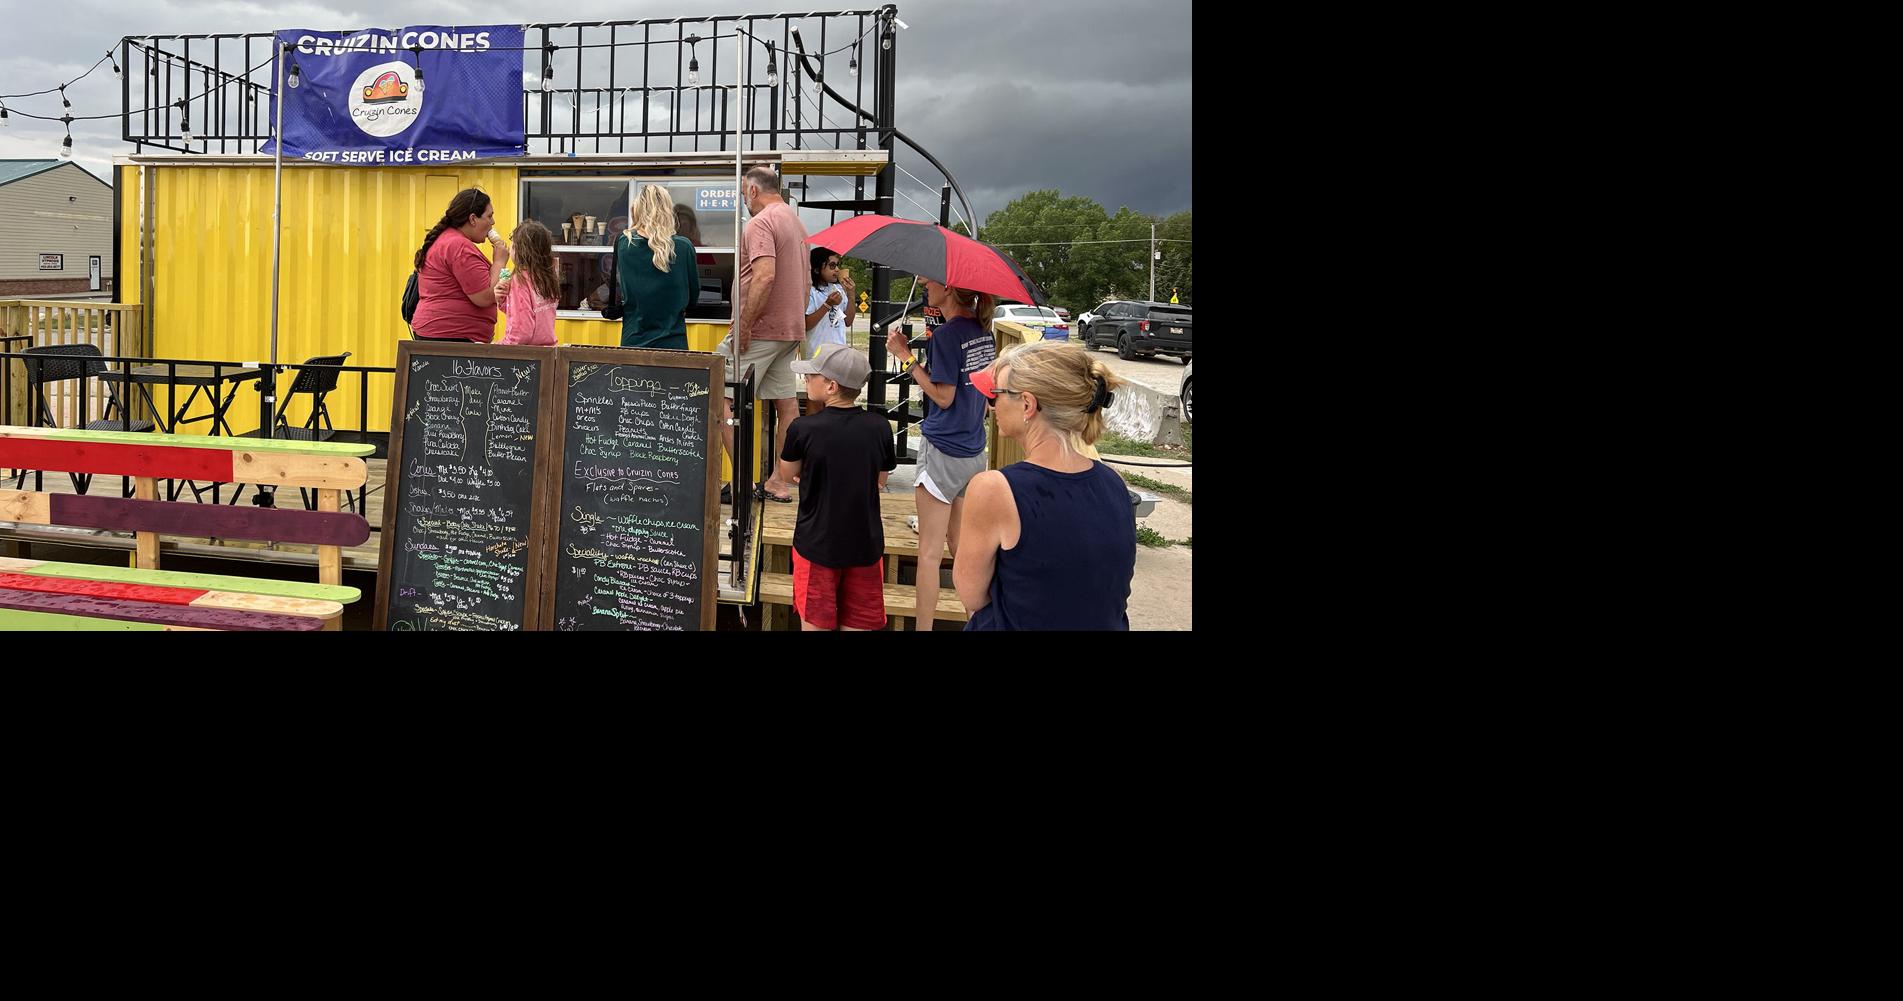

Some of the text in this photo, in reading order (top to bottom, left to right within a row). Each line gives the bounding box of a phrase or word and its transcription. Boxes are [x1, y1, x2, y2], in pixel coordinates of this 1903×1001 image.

[296, 31, 491, 57] CRUIZIN CONES
[352, 106, 418, 122] Cruizin Cones
[303, 149, 477, 163] SOFT SERVE ICE CREAM
[452, 359, 502, 378] 16 Flavors
[604, 366, 667, 398] Toppings
[491, 395, 524, 406] Caramel
[574, 391, 614, 406] Sprinkles
[630, 409, 650, 418] cups
[660, 399, 702, 415] Butterfinger
[572, 421, 600, 432] Snickers
[634, 416, 656, 427] Chips
[491, 432, 513, 441] Lemon
[617, 424, 648, 436] Peanuts
[585, 433, 597, 445] Hot
[598, 434, 620, 451] Fudge
[622, 436, 653, 449] Caramel
[579, 443, 680, 467] Choc Syrup Black Raspberry
[574, 460, 680, 480] Exclusive to Cruizin Cones
[608, 482, 625, 492] and
[570, 505, 604, 528] Single
[617, 513, 643, 526] Waffle
[676, 521, 701, 532] cream
[605, 532, 619, 541] Hot
[619, 533, 643, 545] Fudge
[605, 540, 620, 548] Choc
